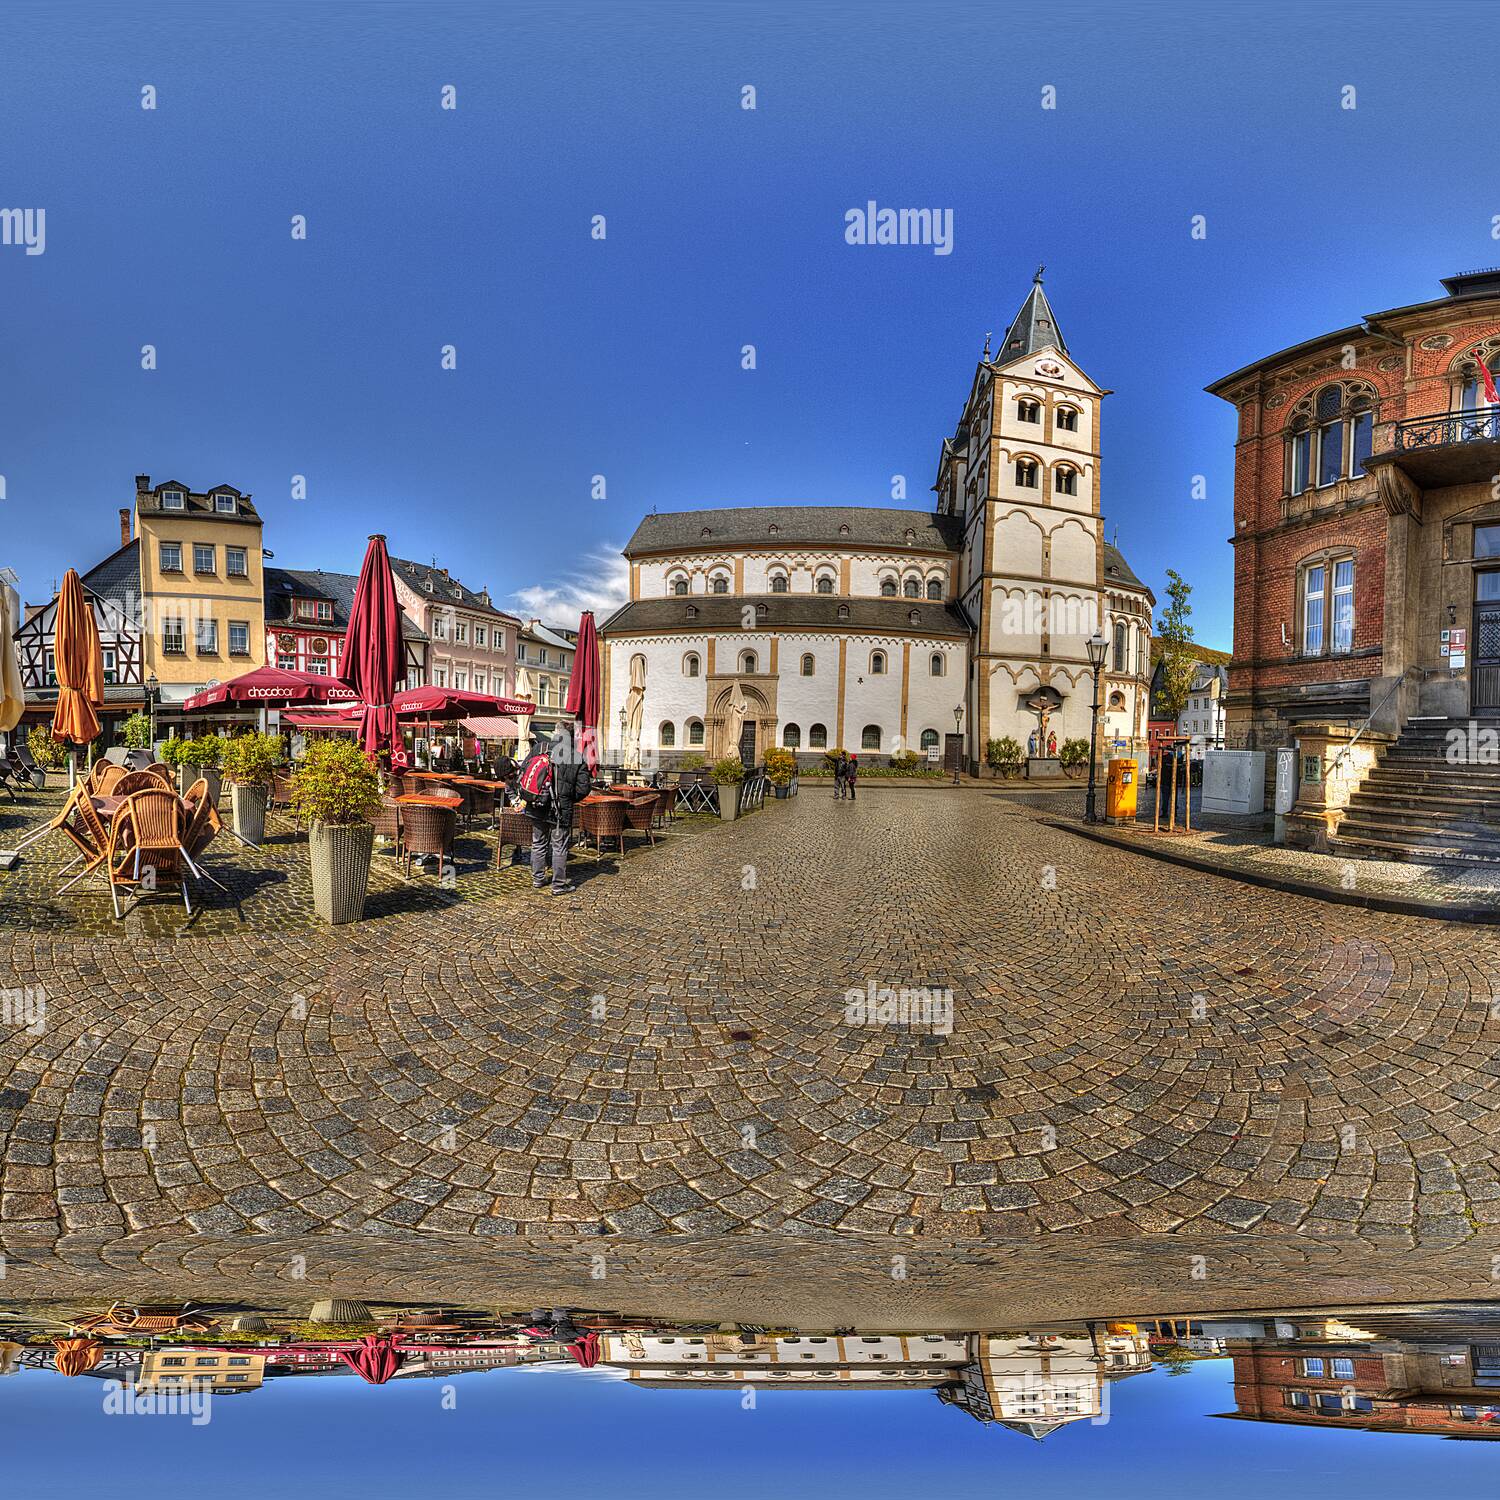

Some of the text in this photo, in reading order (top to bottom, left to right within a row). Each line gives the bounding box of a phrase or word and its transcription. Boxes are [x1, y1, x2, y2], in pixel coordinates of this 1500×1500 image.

[248, 686, 294, 698] chocobar
[328, 687, 359, 698] choco
[400, 702, 423, 711] chocobar
[504, 704, 528, 713] chocobar
[1305, 756, 1318, 764] WC
